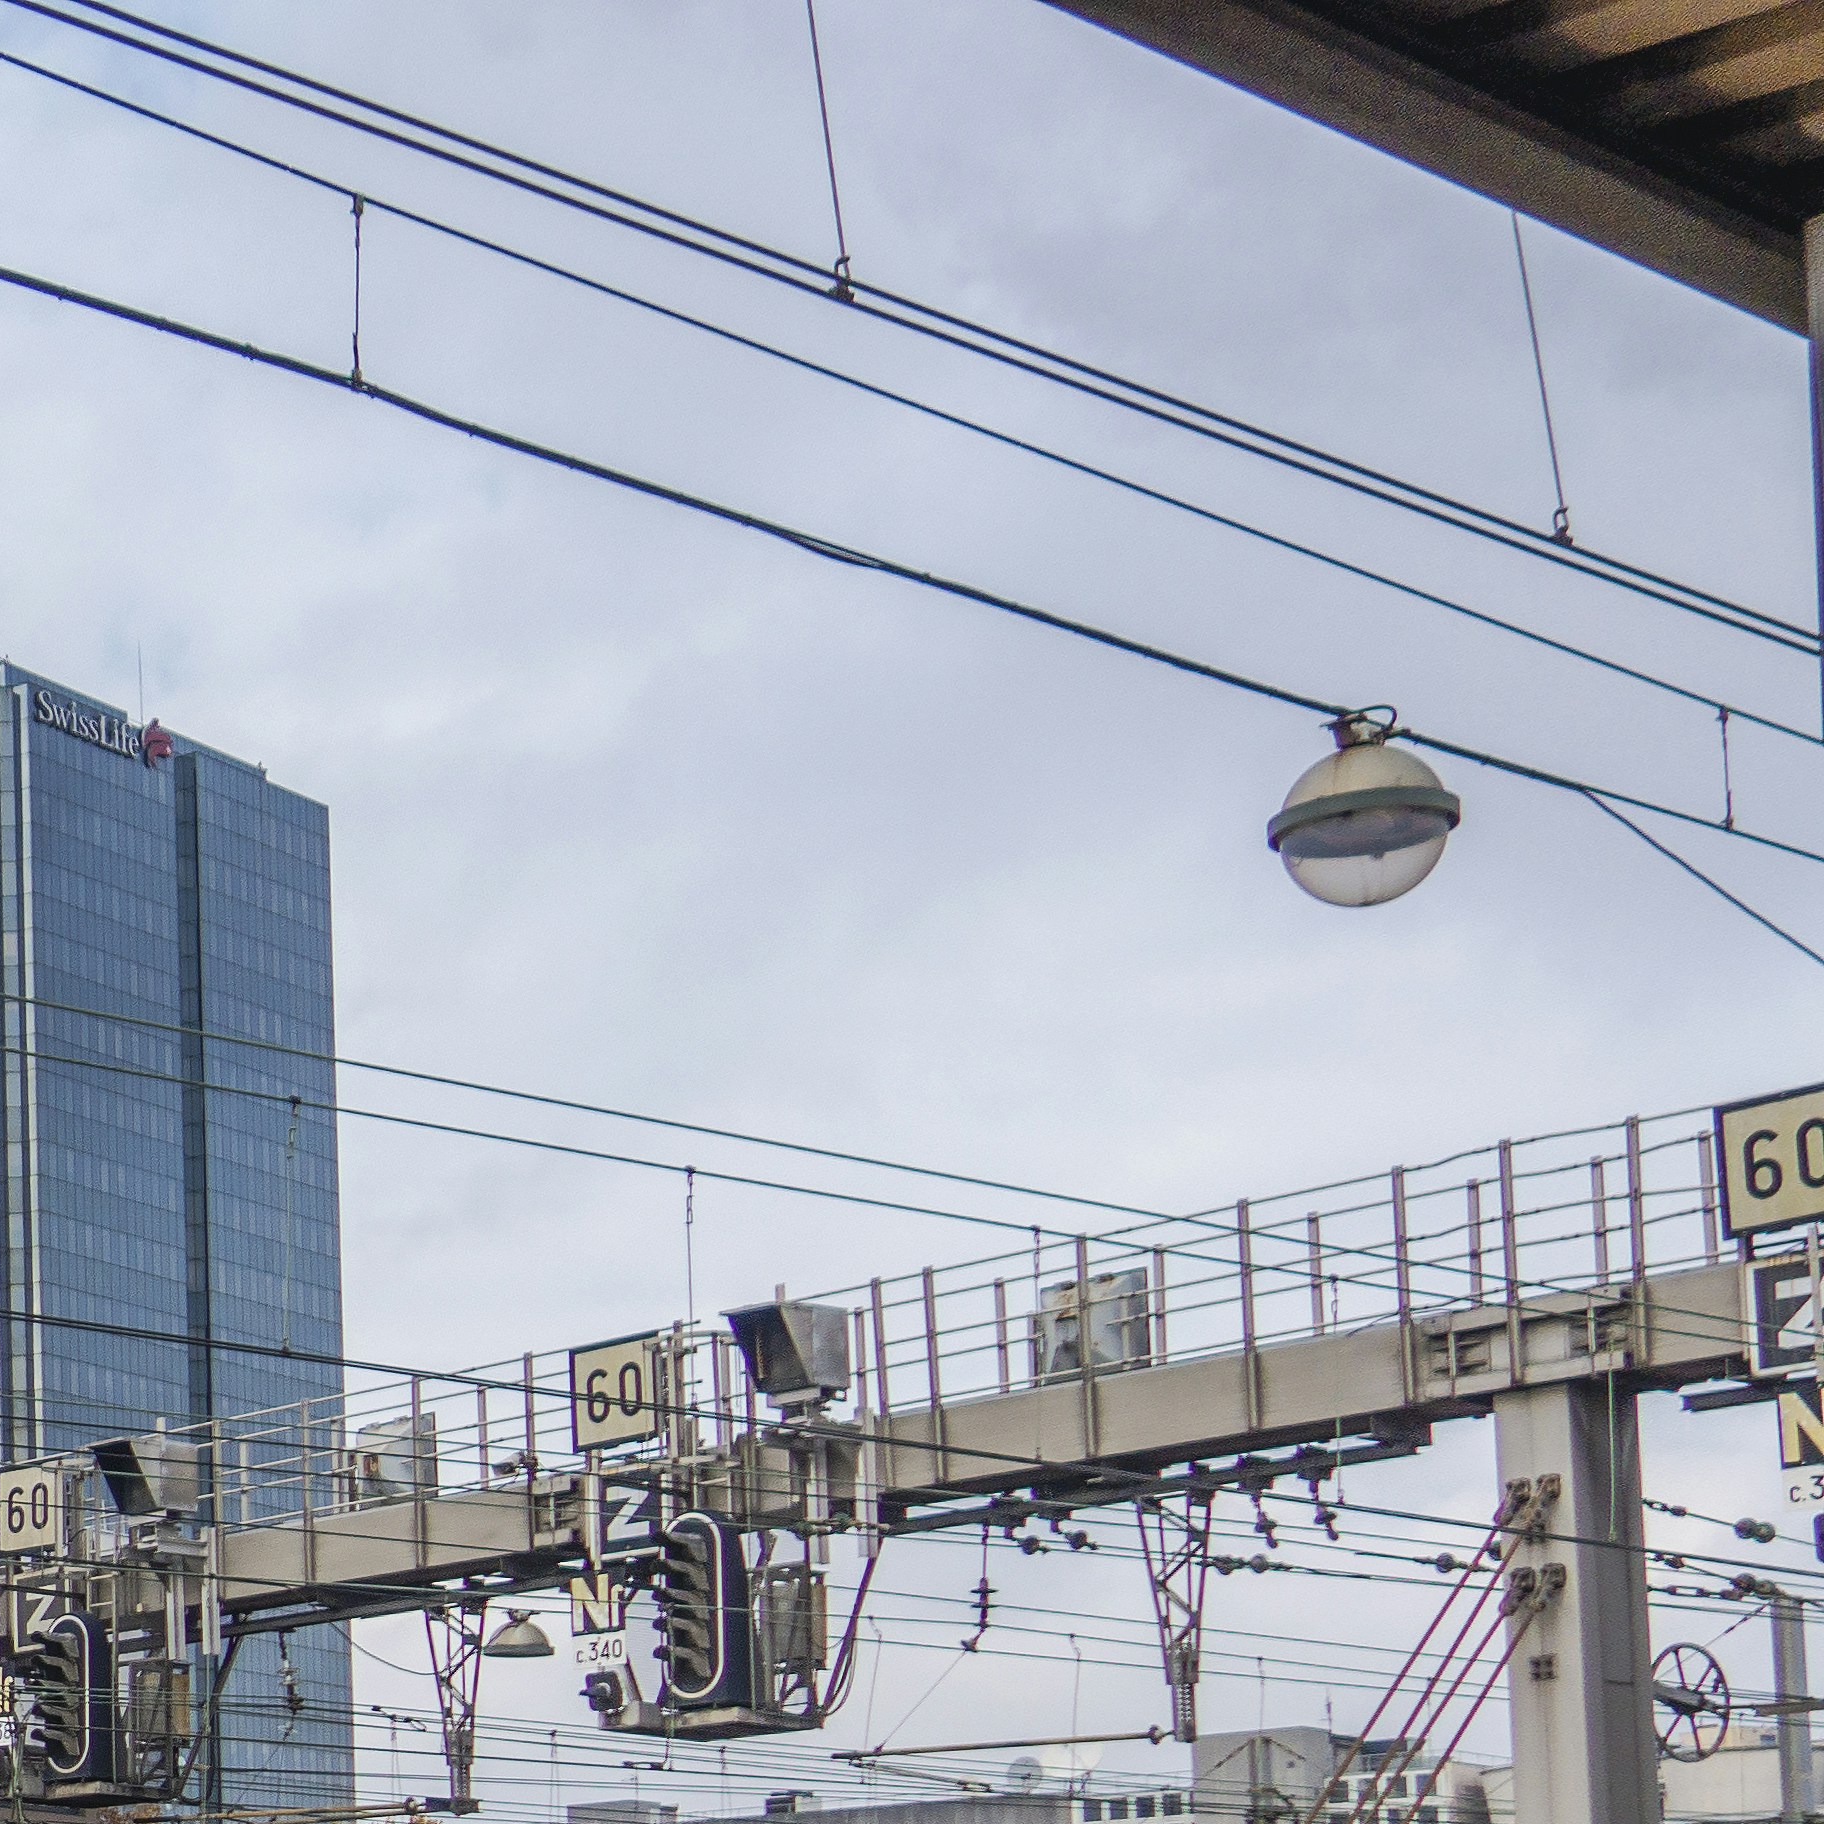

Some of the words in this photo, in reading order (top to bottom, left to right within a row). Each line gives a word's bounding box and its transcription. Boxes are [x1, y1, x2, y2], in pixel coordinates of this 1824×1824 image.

[36, 689, 140, 758] SwissLife
[586, 1361, 643, 1423] 60
[7, 1481, 49, 1534] 60
[606, 1486, 650, 1541] Z
[576, 1639, 623, 1664] c.340
